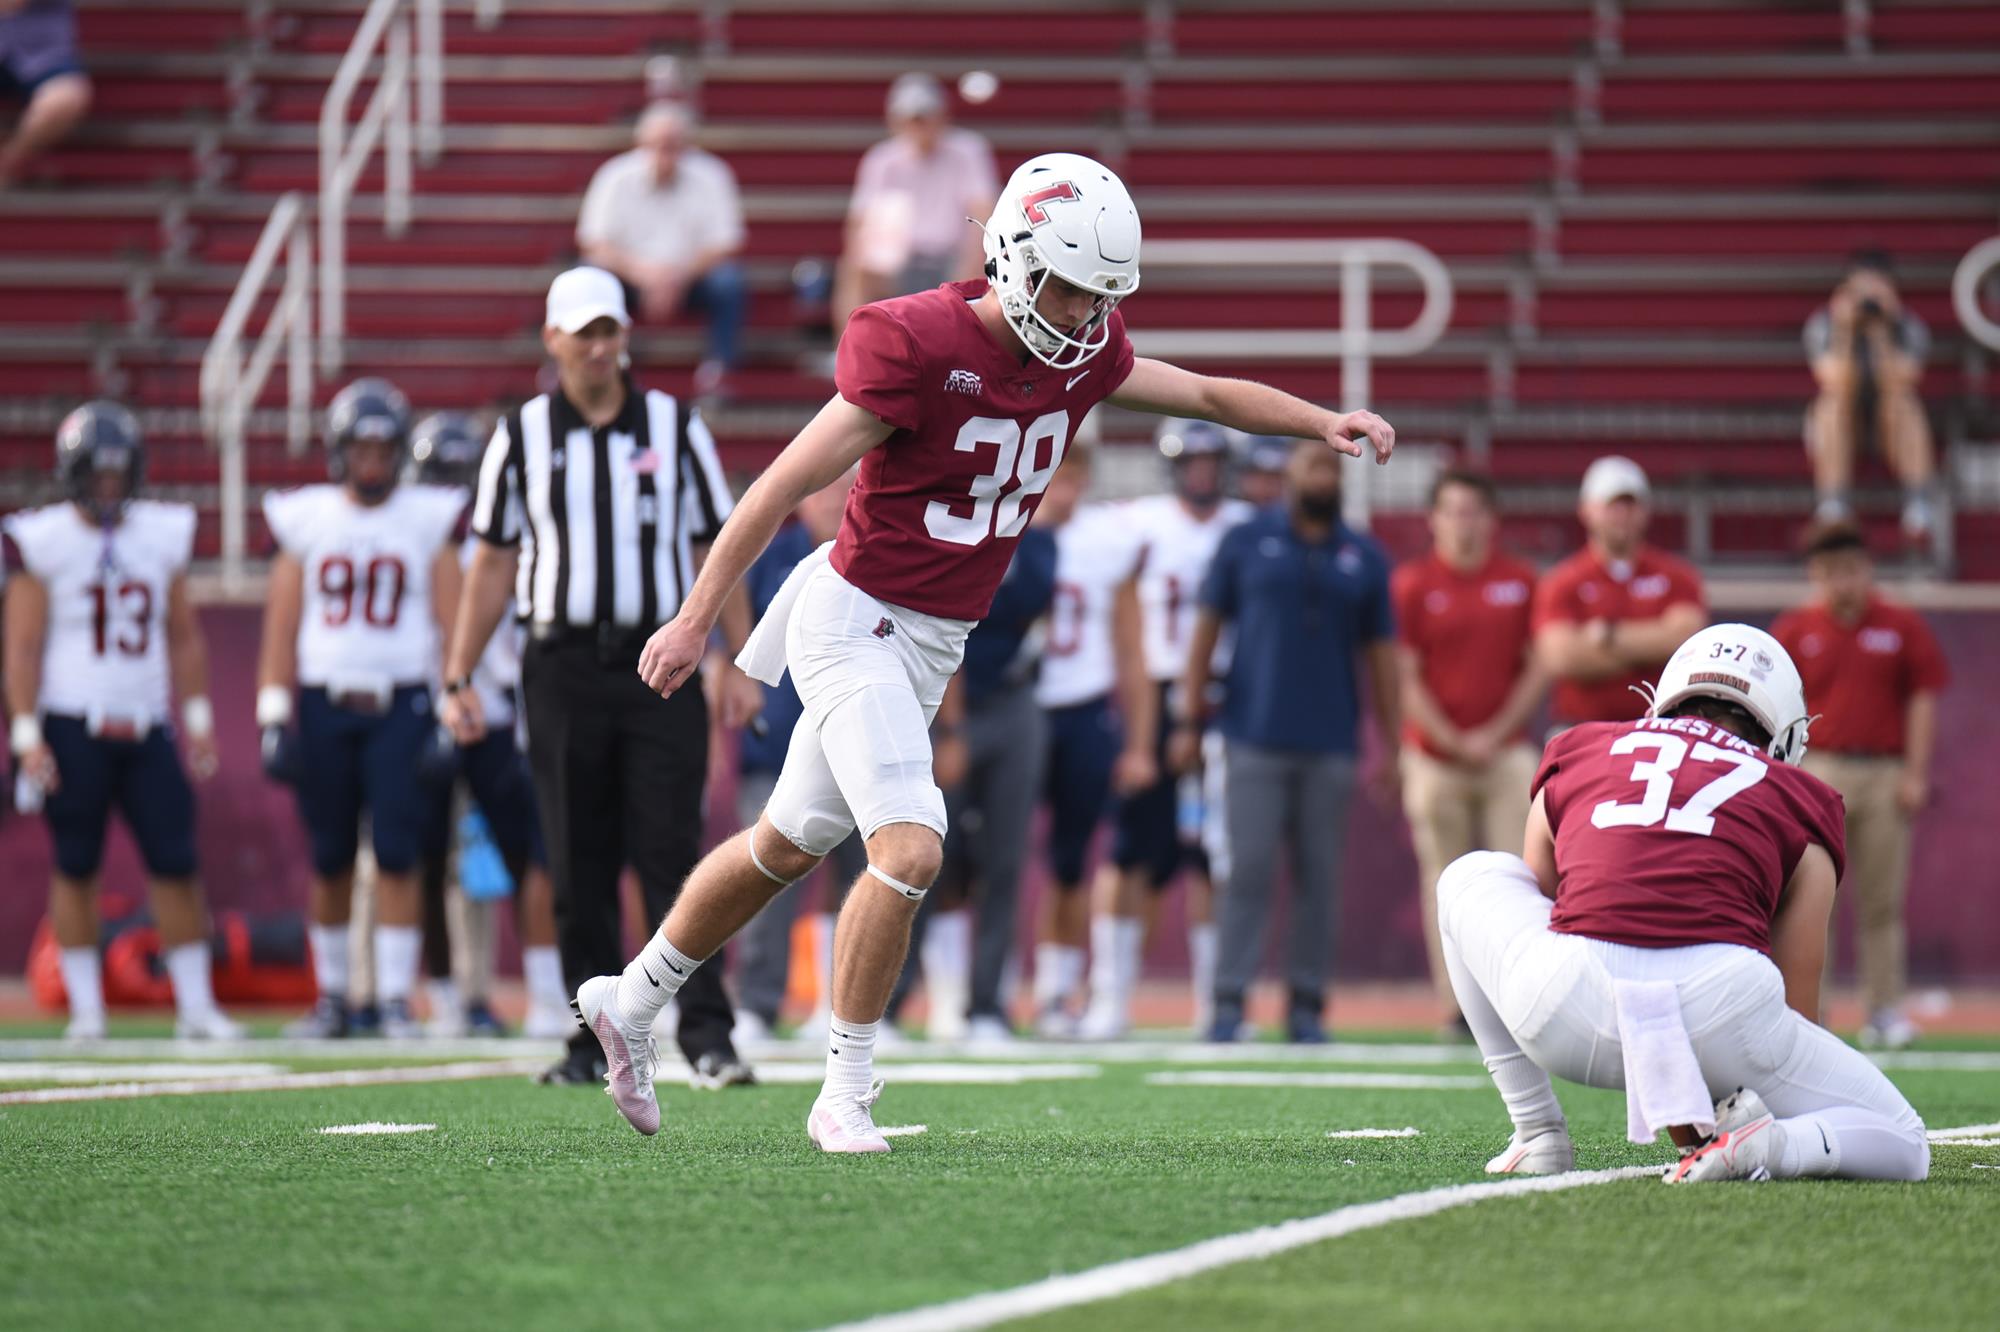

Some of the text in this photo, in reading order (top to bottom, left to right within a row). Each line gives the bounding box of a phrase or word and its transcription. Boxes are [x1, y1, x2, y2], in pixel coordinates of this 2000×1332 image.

[923, 409, 1069, 546] 38
[84, 581, 153, 656] 13
[319, 555, 406, 628] 90
[1590, 731, 1768, 836] 37
